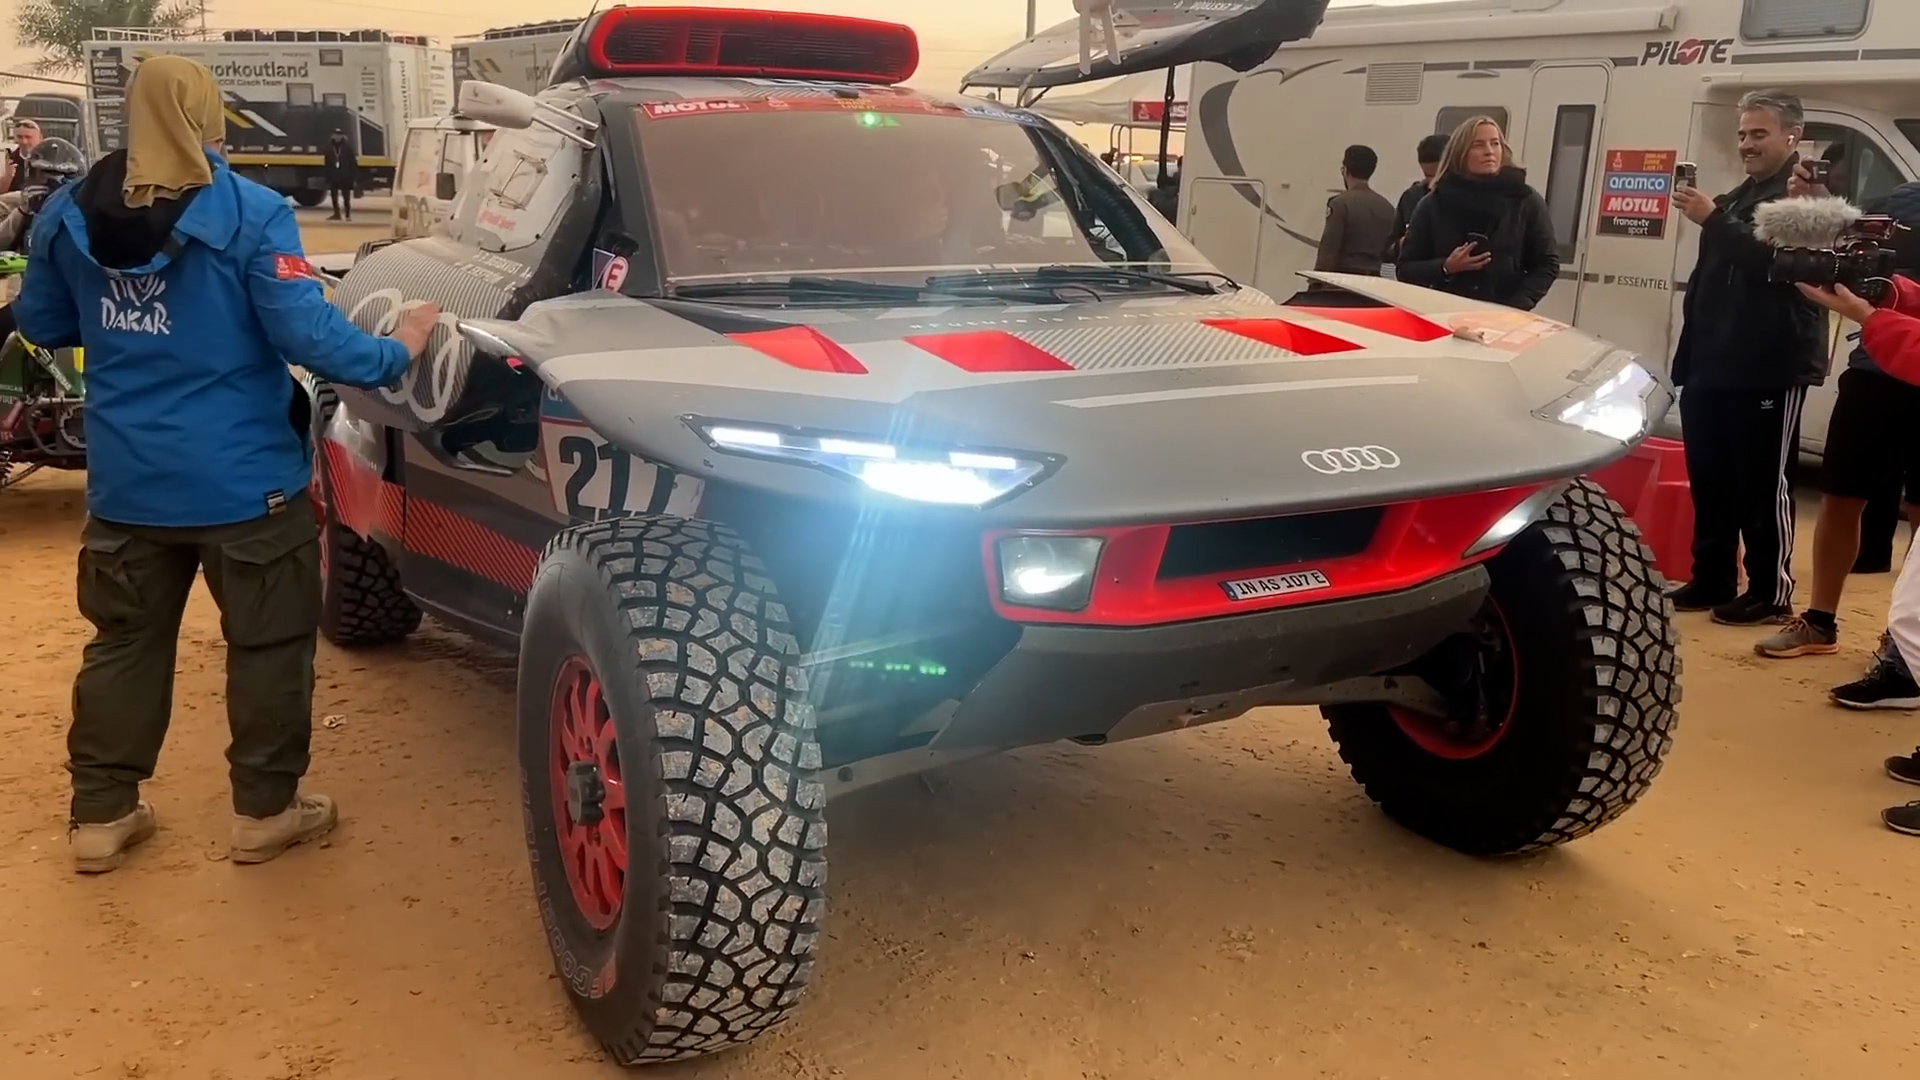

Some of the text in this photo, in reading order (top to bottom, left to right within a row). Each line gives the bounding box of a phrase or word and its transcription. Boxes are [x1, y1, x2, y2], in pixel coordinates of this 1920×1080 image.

[1609, 176, 1665, 191] aramco
[1607, 197, 1660, 213] MOTUL
[1627, 226, 1648, 236] sport
[605, 263, 624, 291] E
[1617, 275, 1669, 290] ESSENTIEL
[101, 297, 170, 335] DAKAR
[1236, 571, 1326, 595] IN AS 107 E
